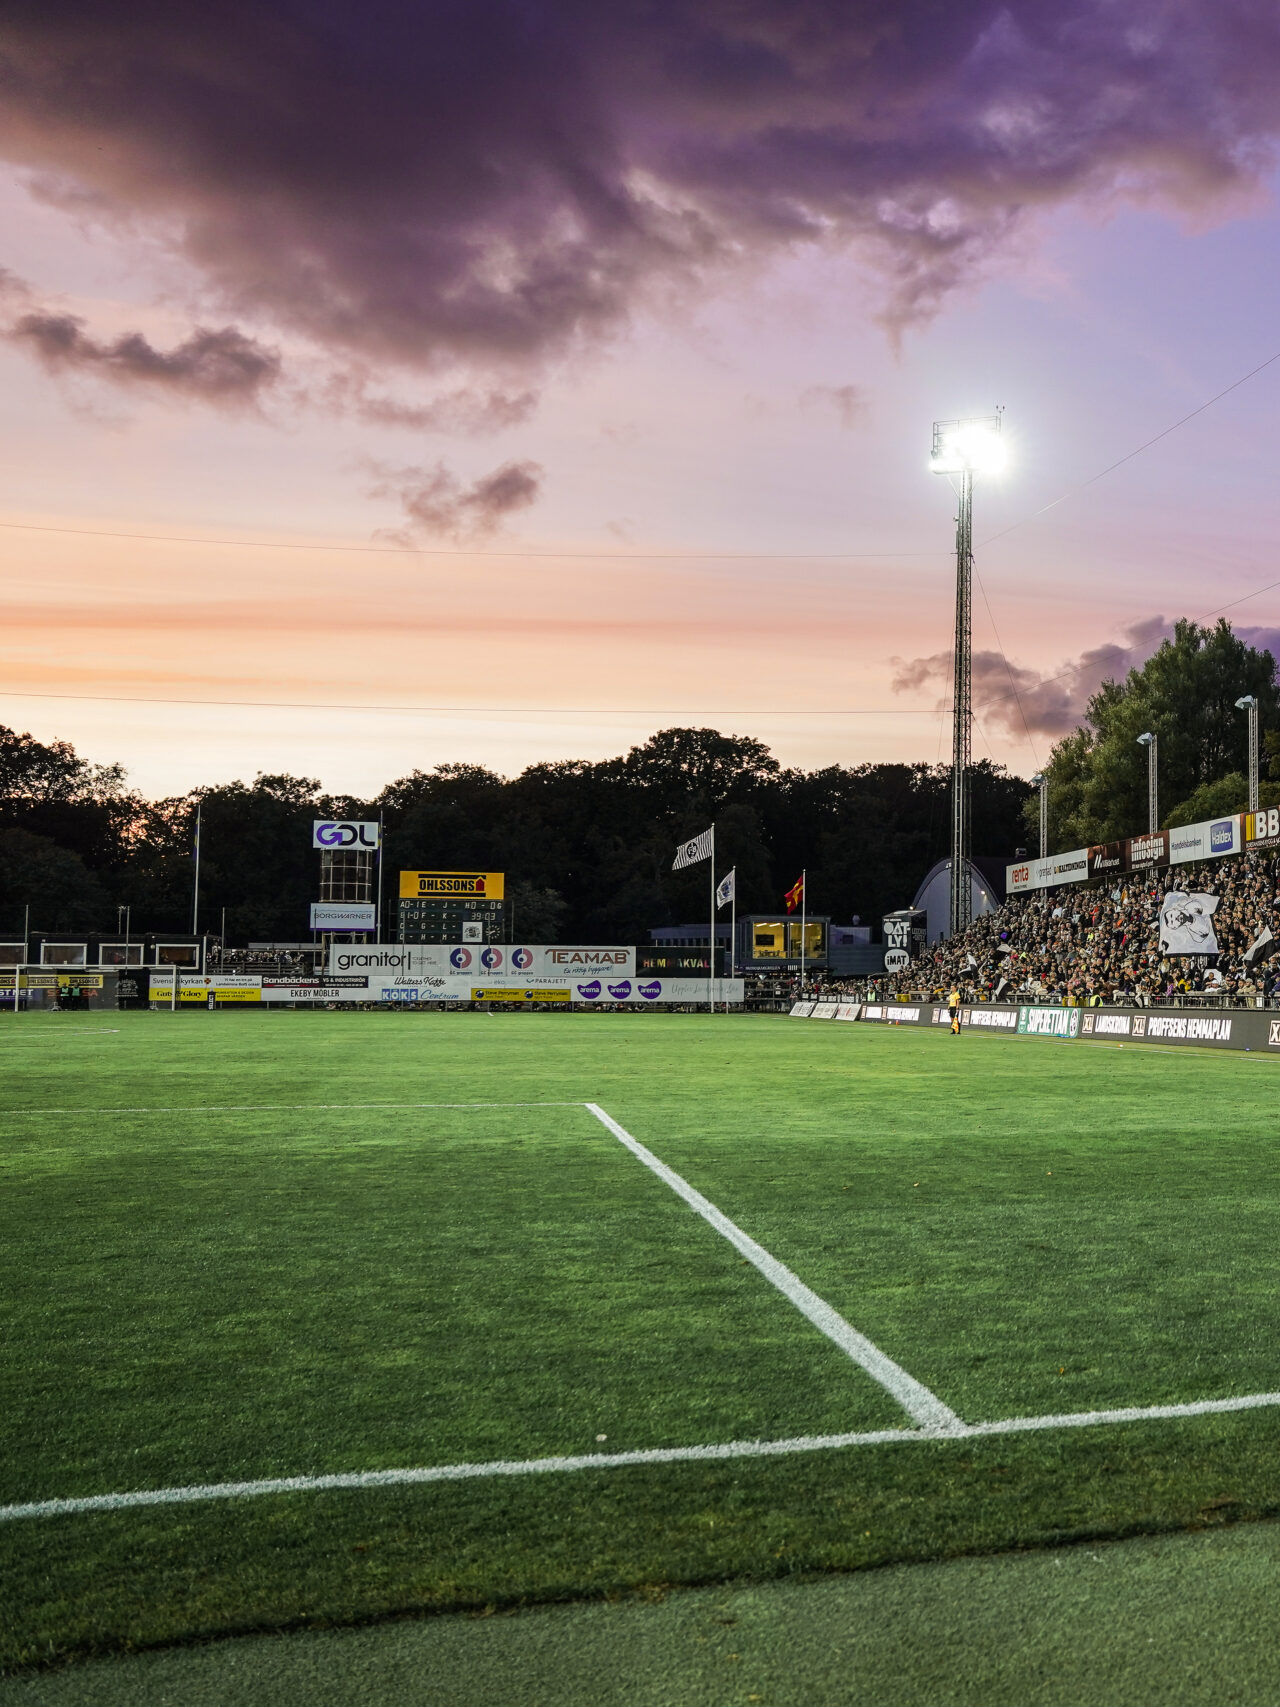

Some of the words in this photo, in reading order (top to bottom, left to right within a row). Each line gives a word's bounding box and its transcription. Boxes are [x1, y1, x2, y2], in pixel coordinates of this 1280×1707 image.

[316, 824, 375, 846] GDL
[1212, 830, 1232, 845] Haldex
[1131, 836, 1165, 862] infosign
[1171, 839, 1202, 850] Handelsbanken
[1012, 867, 1029, 883] renta
[419, 880, 475, 891] OHLSSONS
[314, 912, 372, 920] BORGWARNER
[888, 935, 908, 947] LY!
[338, 952, 406, 970] granitor
[547, 949, 629, 964] TEAMAB
[181, 977, 204, 986] kyrkan
[394, 977, 423, 985] Walters
[423, 977, 447, 987] Kaffe
[183, 990, 202, 998] Glory
[313, 989, 340, 997] MÖBLER
[382, 990, 418, 1000] KÖKS
[421, 990, 460, 999] Centrum
[1027, 1008, 1070, 1035] SUPERETTAN
[1095, 1015, 1130, 1034] LANDSKRONA
[1148, 1016, 1187, 1038] PROFFSENS
[1187, 1018, 1232, 1040] HEMMAPLAN
